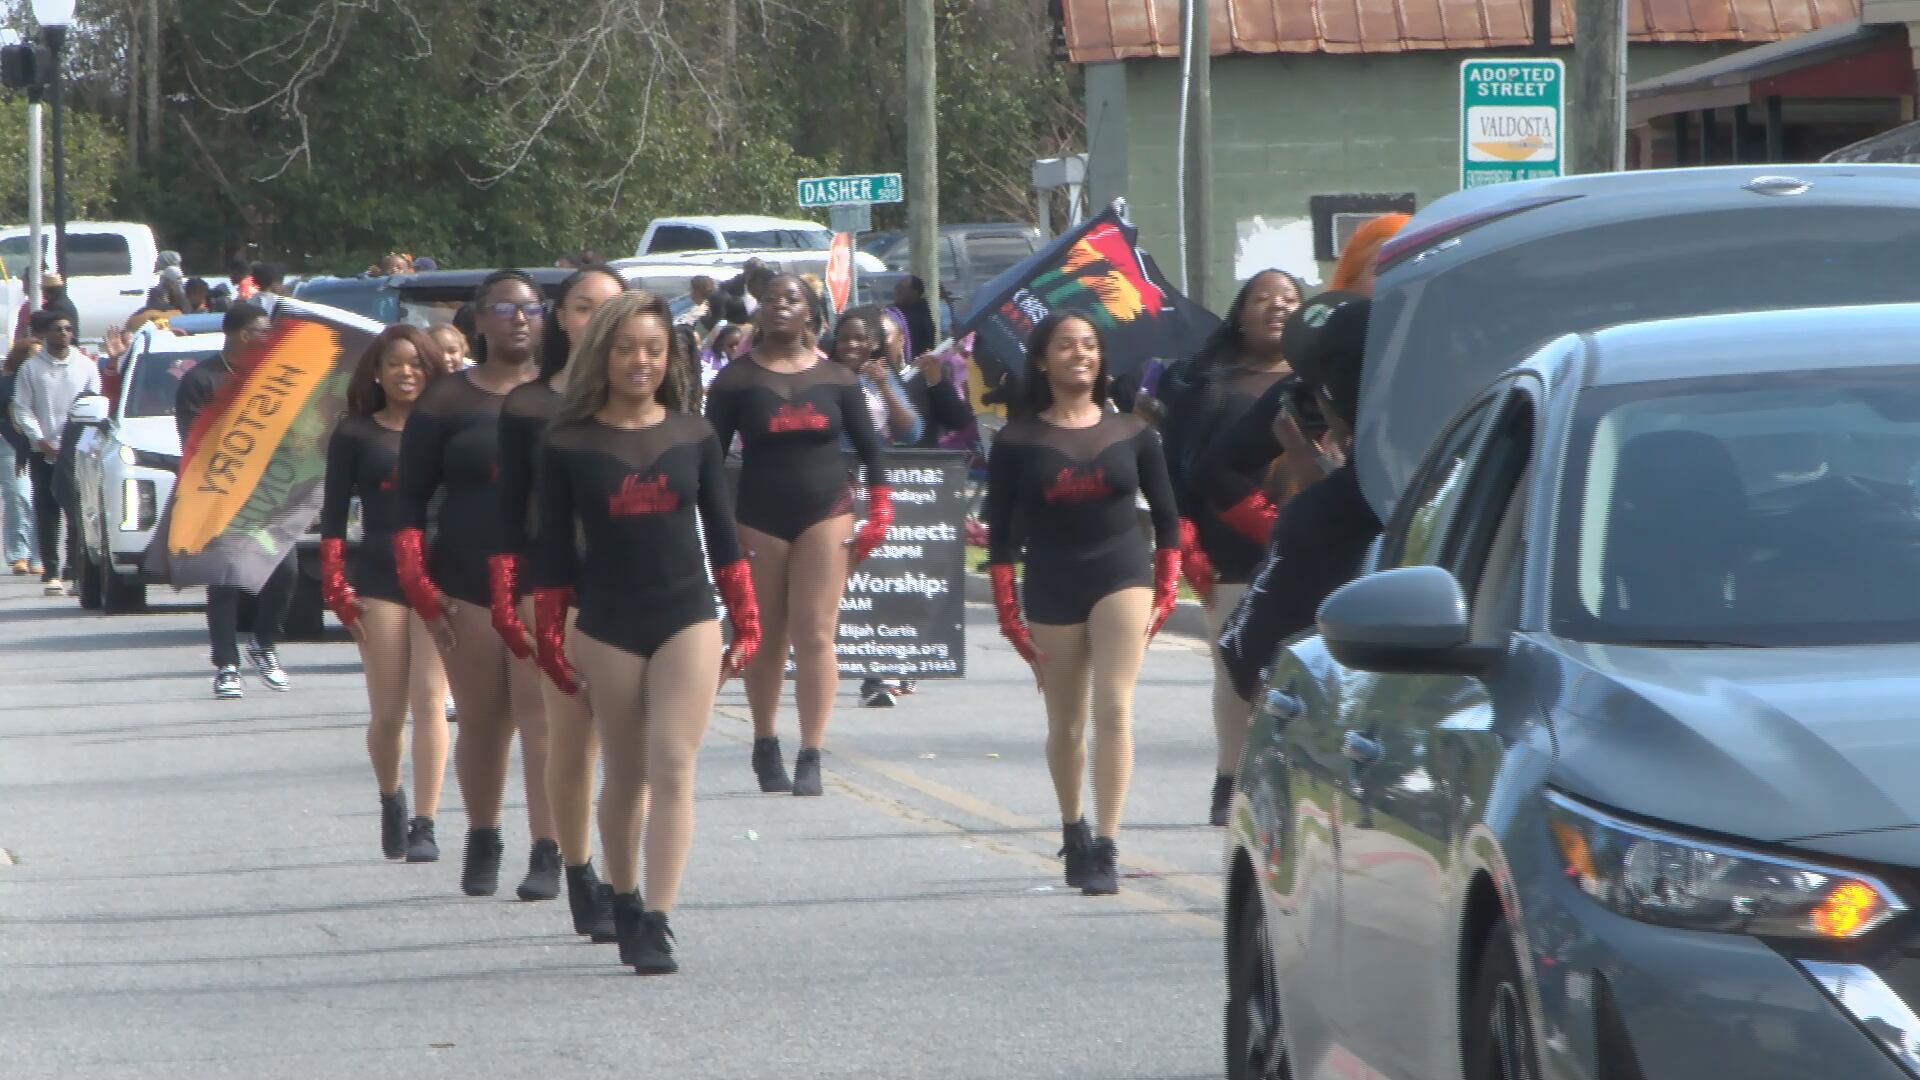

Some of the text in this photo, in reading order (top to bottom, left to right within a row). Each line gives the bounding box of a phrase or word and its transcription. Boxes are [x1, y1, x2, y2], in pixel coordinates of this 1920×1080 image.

[1470, 67, 1555, 82] ADOPTED
[1477, 83, 1547, 97] STREET
[1481, 116, 1552, 137] VALDOSTA
[804, 175, 898, 203] DASHER LN
[858, 465, 944, 484] anna:
[886, 488, 937, 504] ndays)
[853, 519, 957, 542] nnect:
[847, 571, 949, 598] Worship:
[838, 623, 918, 639] Elijah Curtis
[869, 660, 917, 674] Georgia
